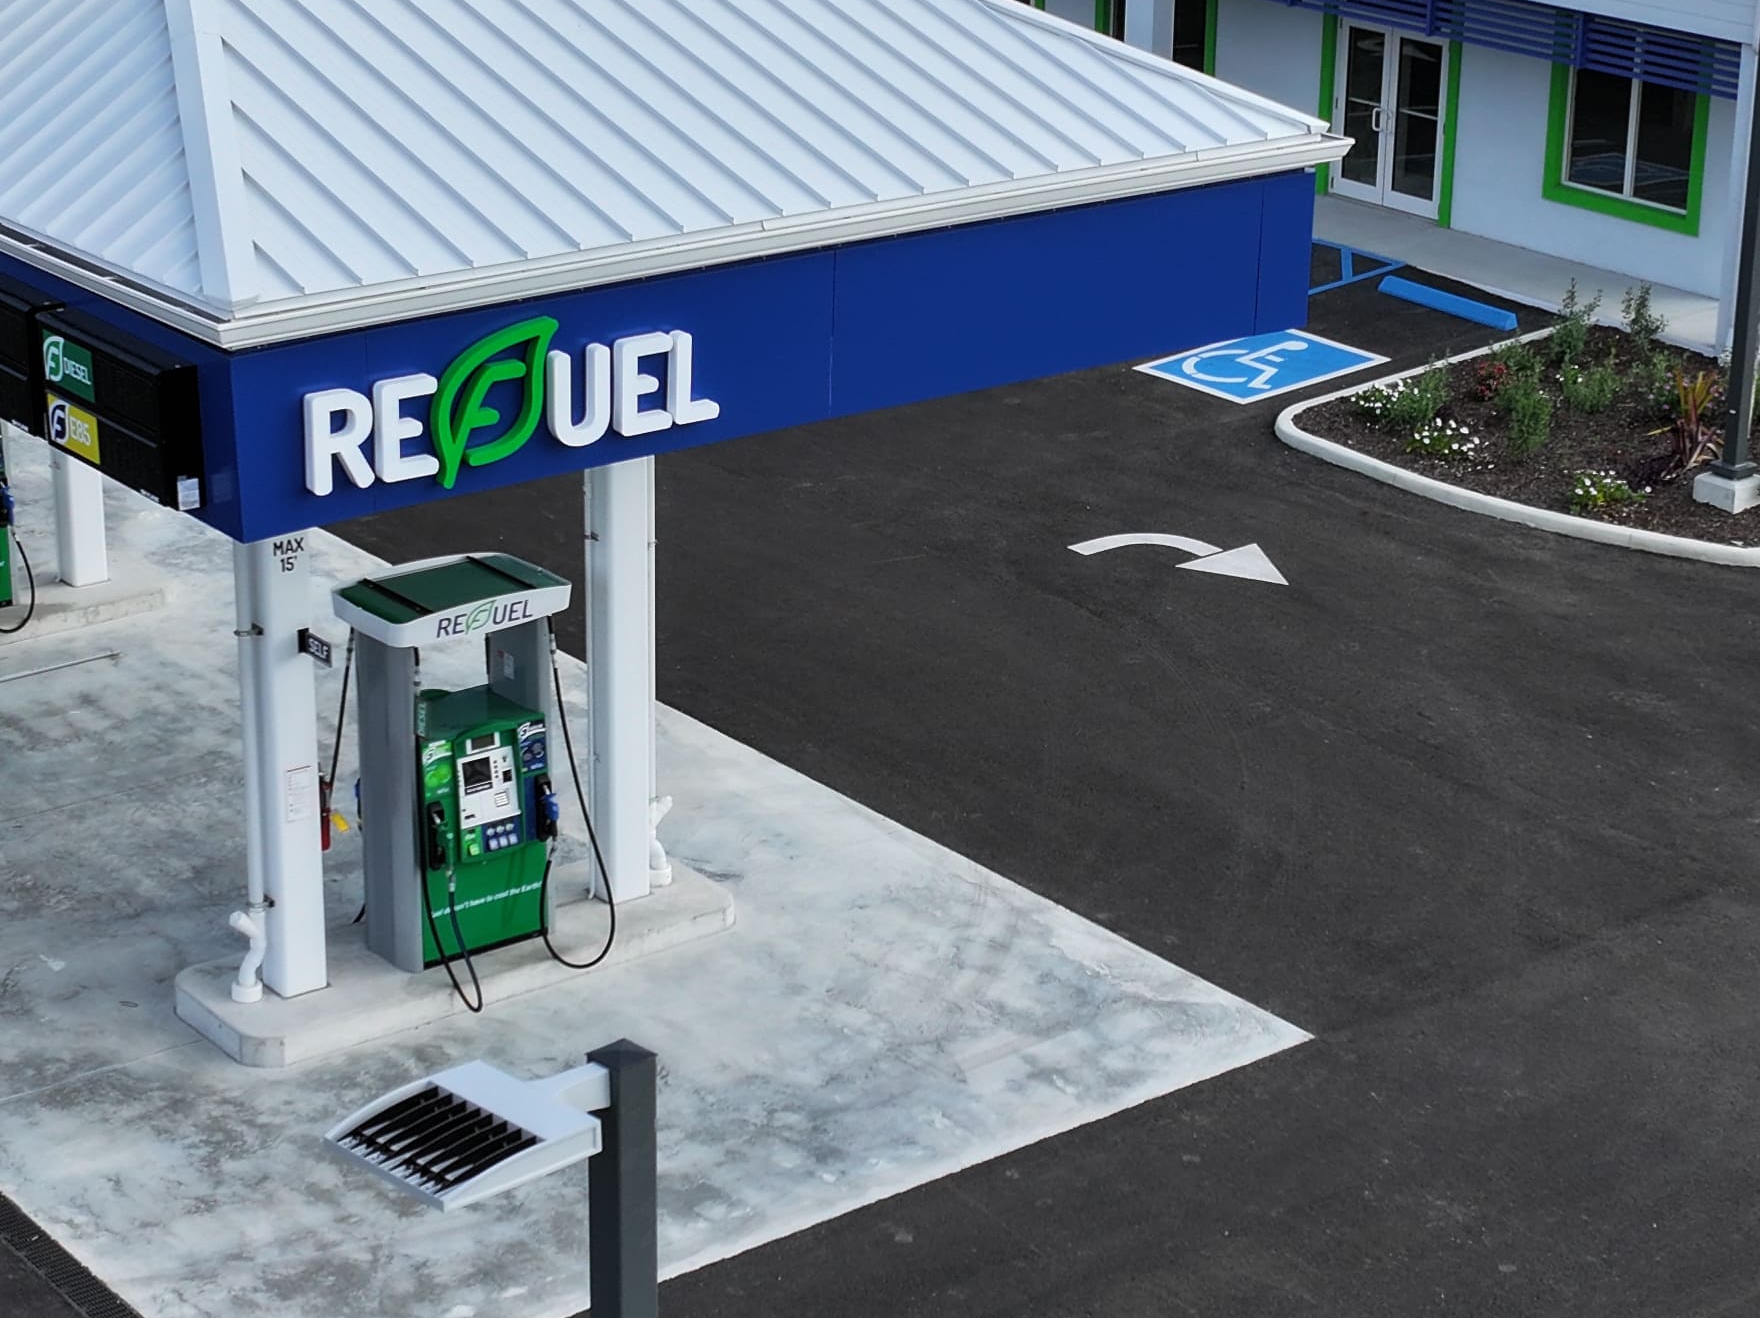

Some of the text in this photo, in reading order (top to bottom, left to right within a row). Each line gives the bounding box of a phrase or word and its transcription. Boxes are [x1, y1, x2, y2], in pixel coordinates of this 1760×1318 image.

[63, 357, 91, 385] DIESEL
[303, 315, 720, 497] REFUEL
[69, 416, 91, 446] E85
[273, 537, 305, 557] MAX
[436, 599, 534, 638] REFUEL
[307, 638, 329, 659] SELF
